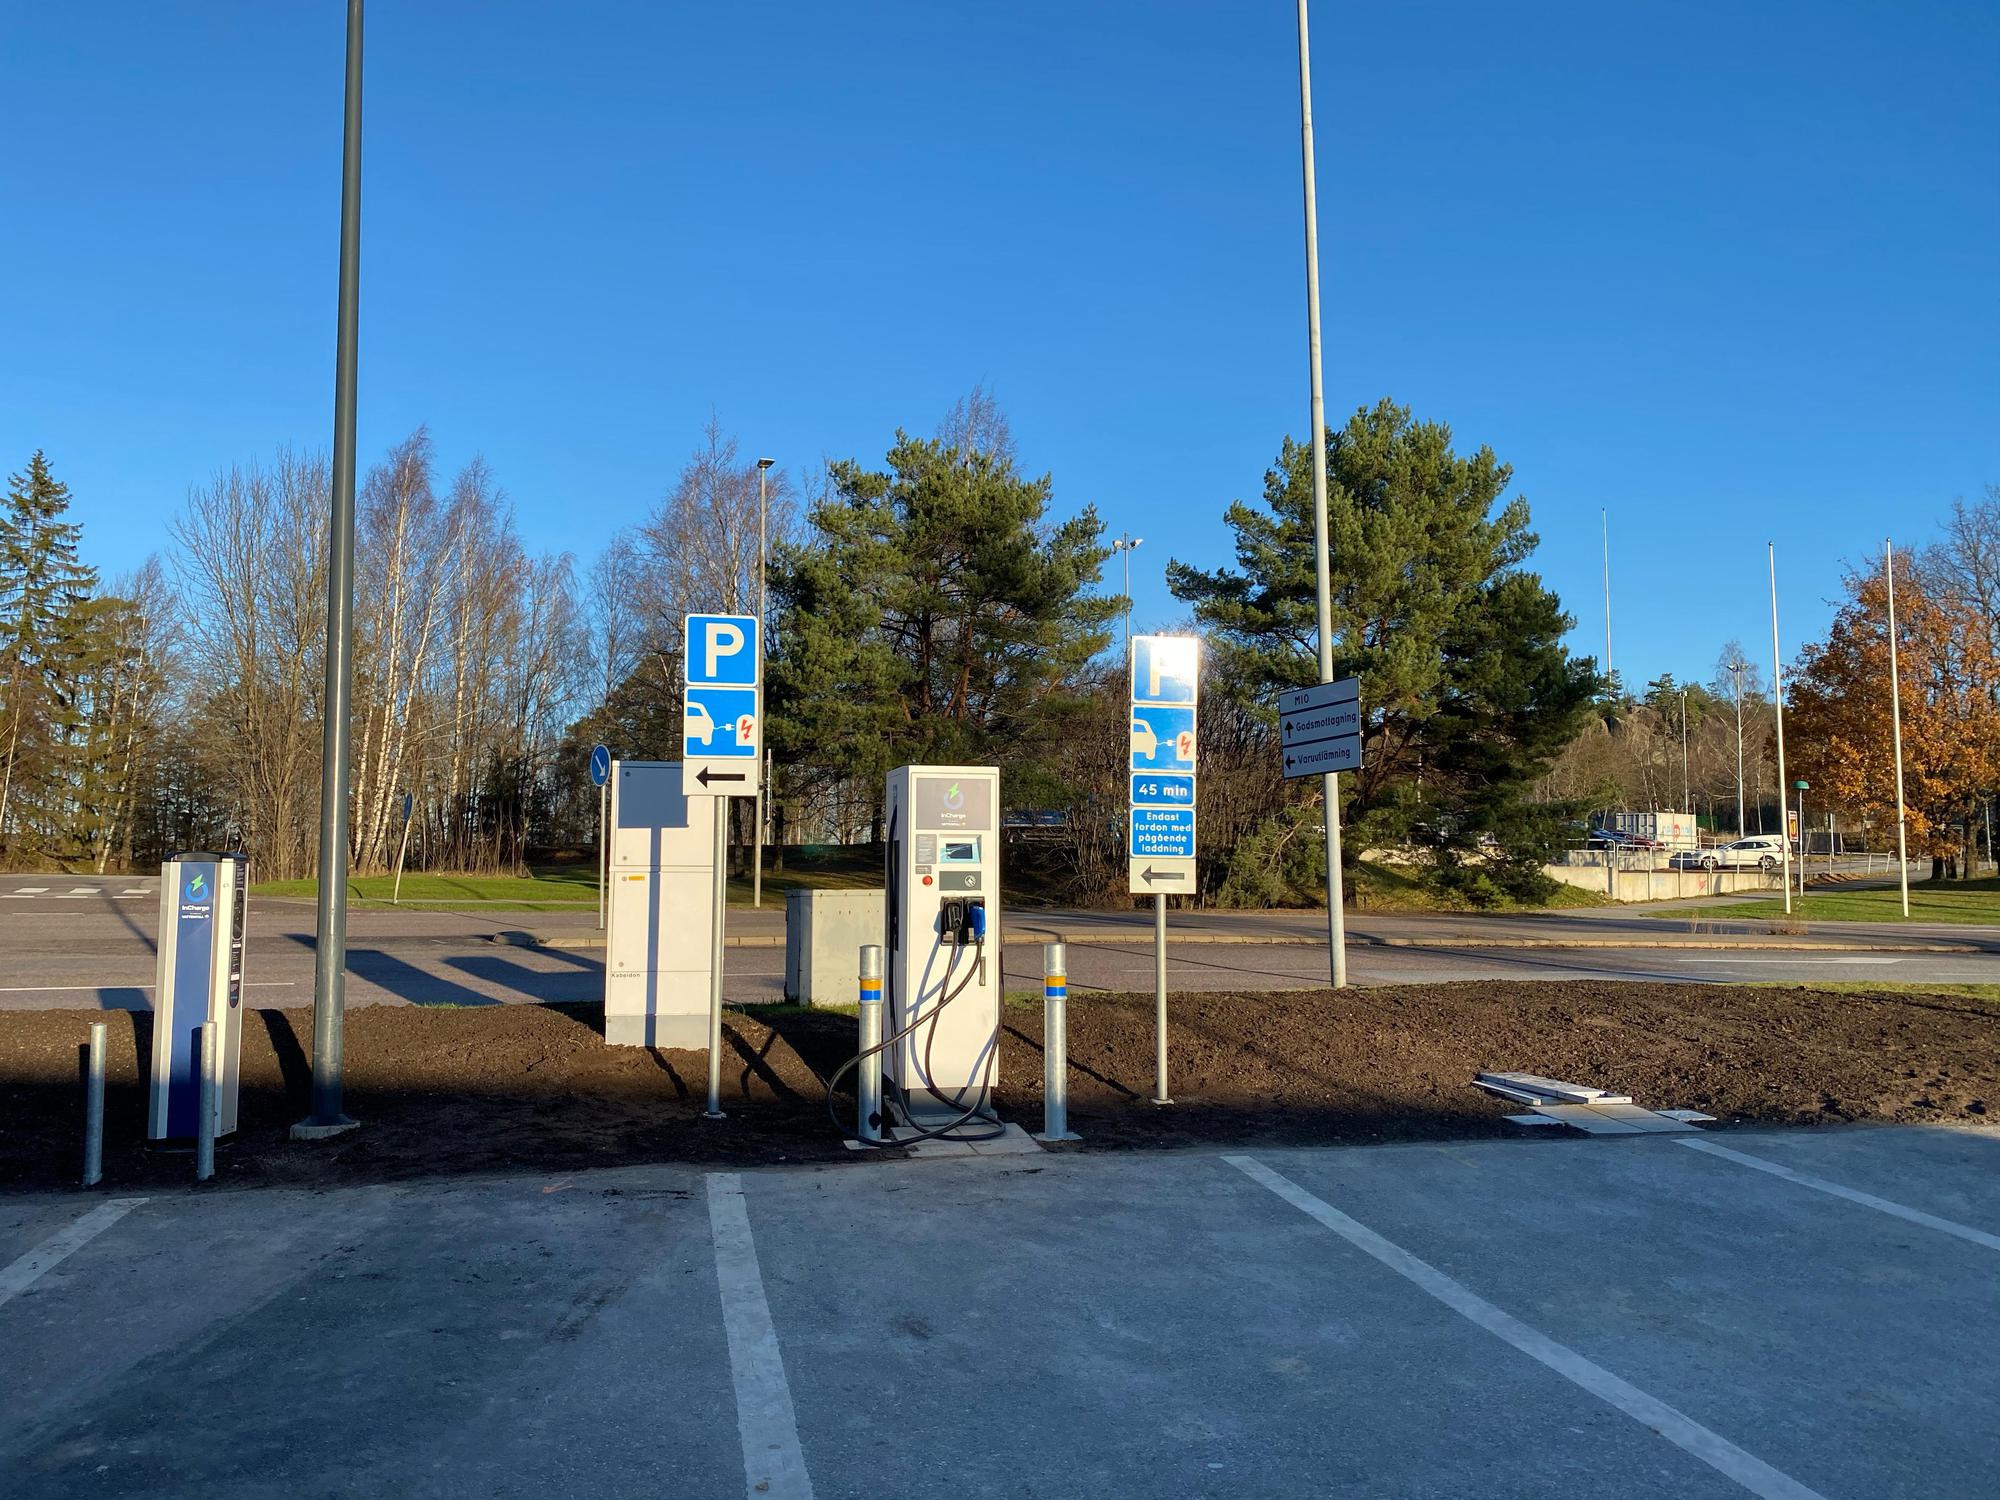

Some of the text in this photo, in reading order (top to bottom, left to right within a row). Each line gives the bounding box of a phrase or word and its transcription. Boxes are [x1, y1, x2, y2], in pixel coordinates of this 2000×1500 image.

[705, 622, 745, 677] P
[1294, 694, 1309, 705] MIO
[1296, 712, 1356, 731] Godsmottagning
[1298, 747, 1351, 764] Varuutlämning
[1138, 783, 1188, 797] 45 min
[1146, 811, 1180, 821] Endast
[1135, 822, 1192, 832] fordon med
[1138, 833, 1188, 844] pågående
[1141, 843, 1184, 855] laddning
